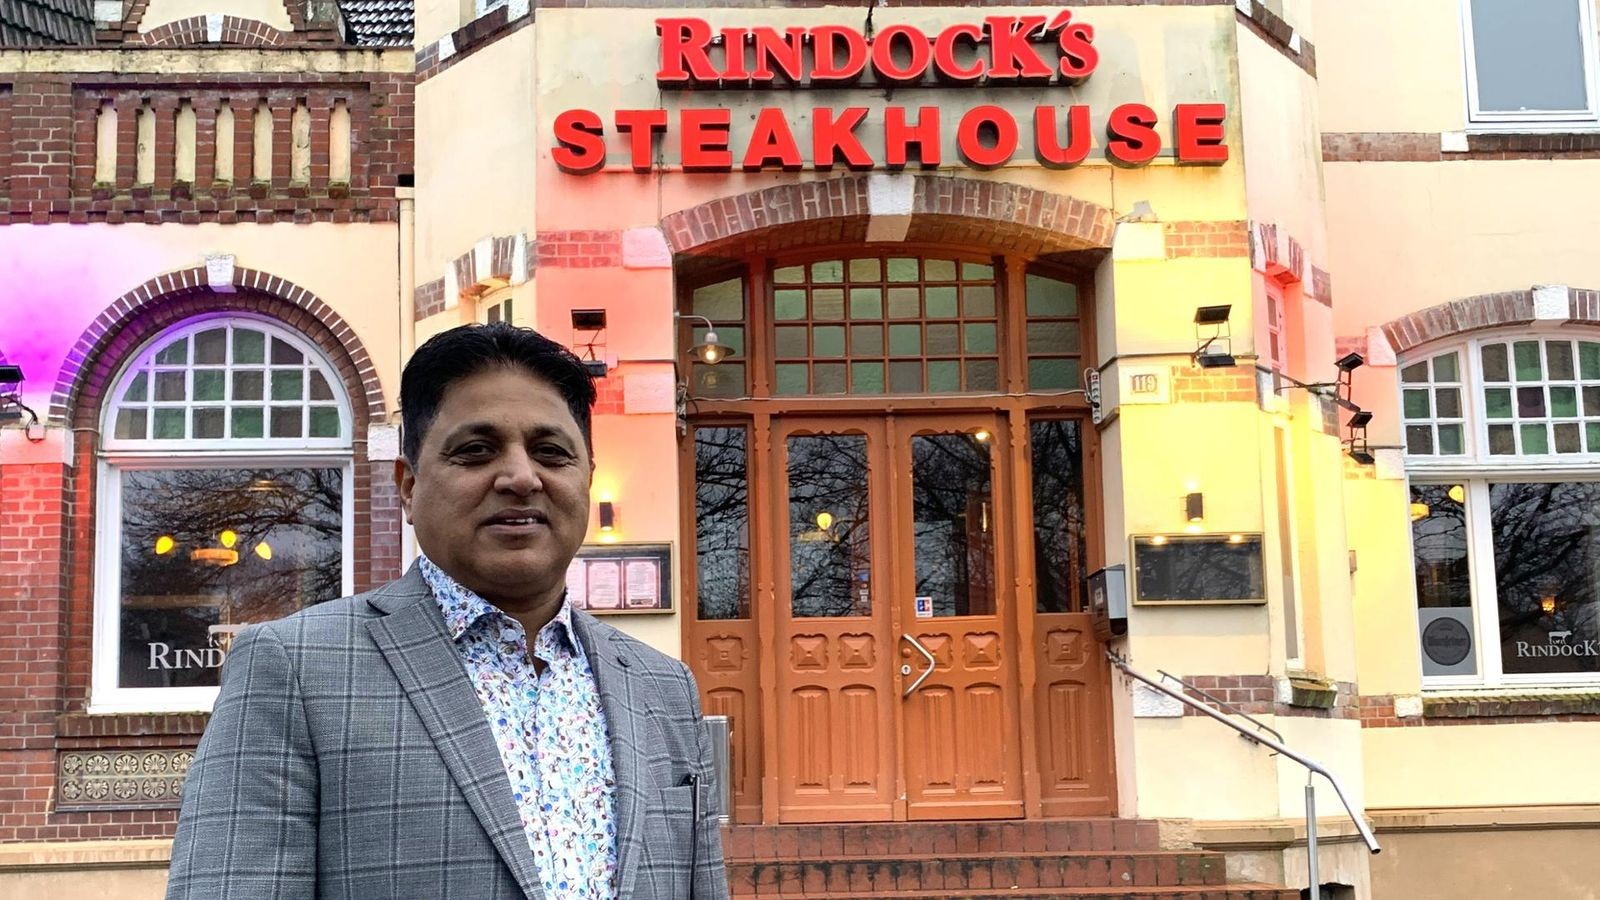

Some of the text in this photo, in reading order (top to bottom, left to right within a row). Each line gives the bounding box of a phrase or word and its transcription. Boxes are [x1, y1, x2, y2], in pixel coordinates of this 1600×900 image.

[551, 103, 1228, 172] STEAKHOUSE
[1132, 374, 1157, 393] 119
[148, 642, 227, 669] RIND
